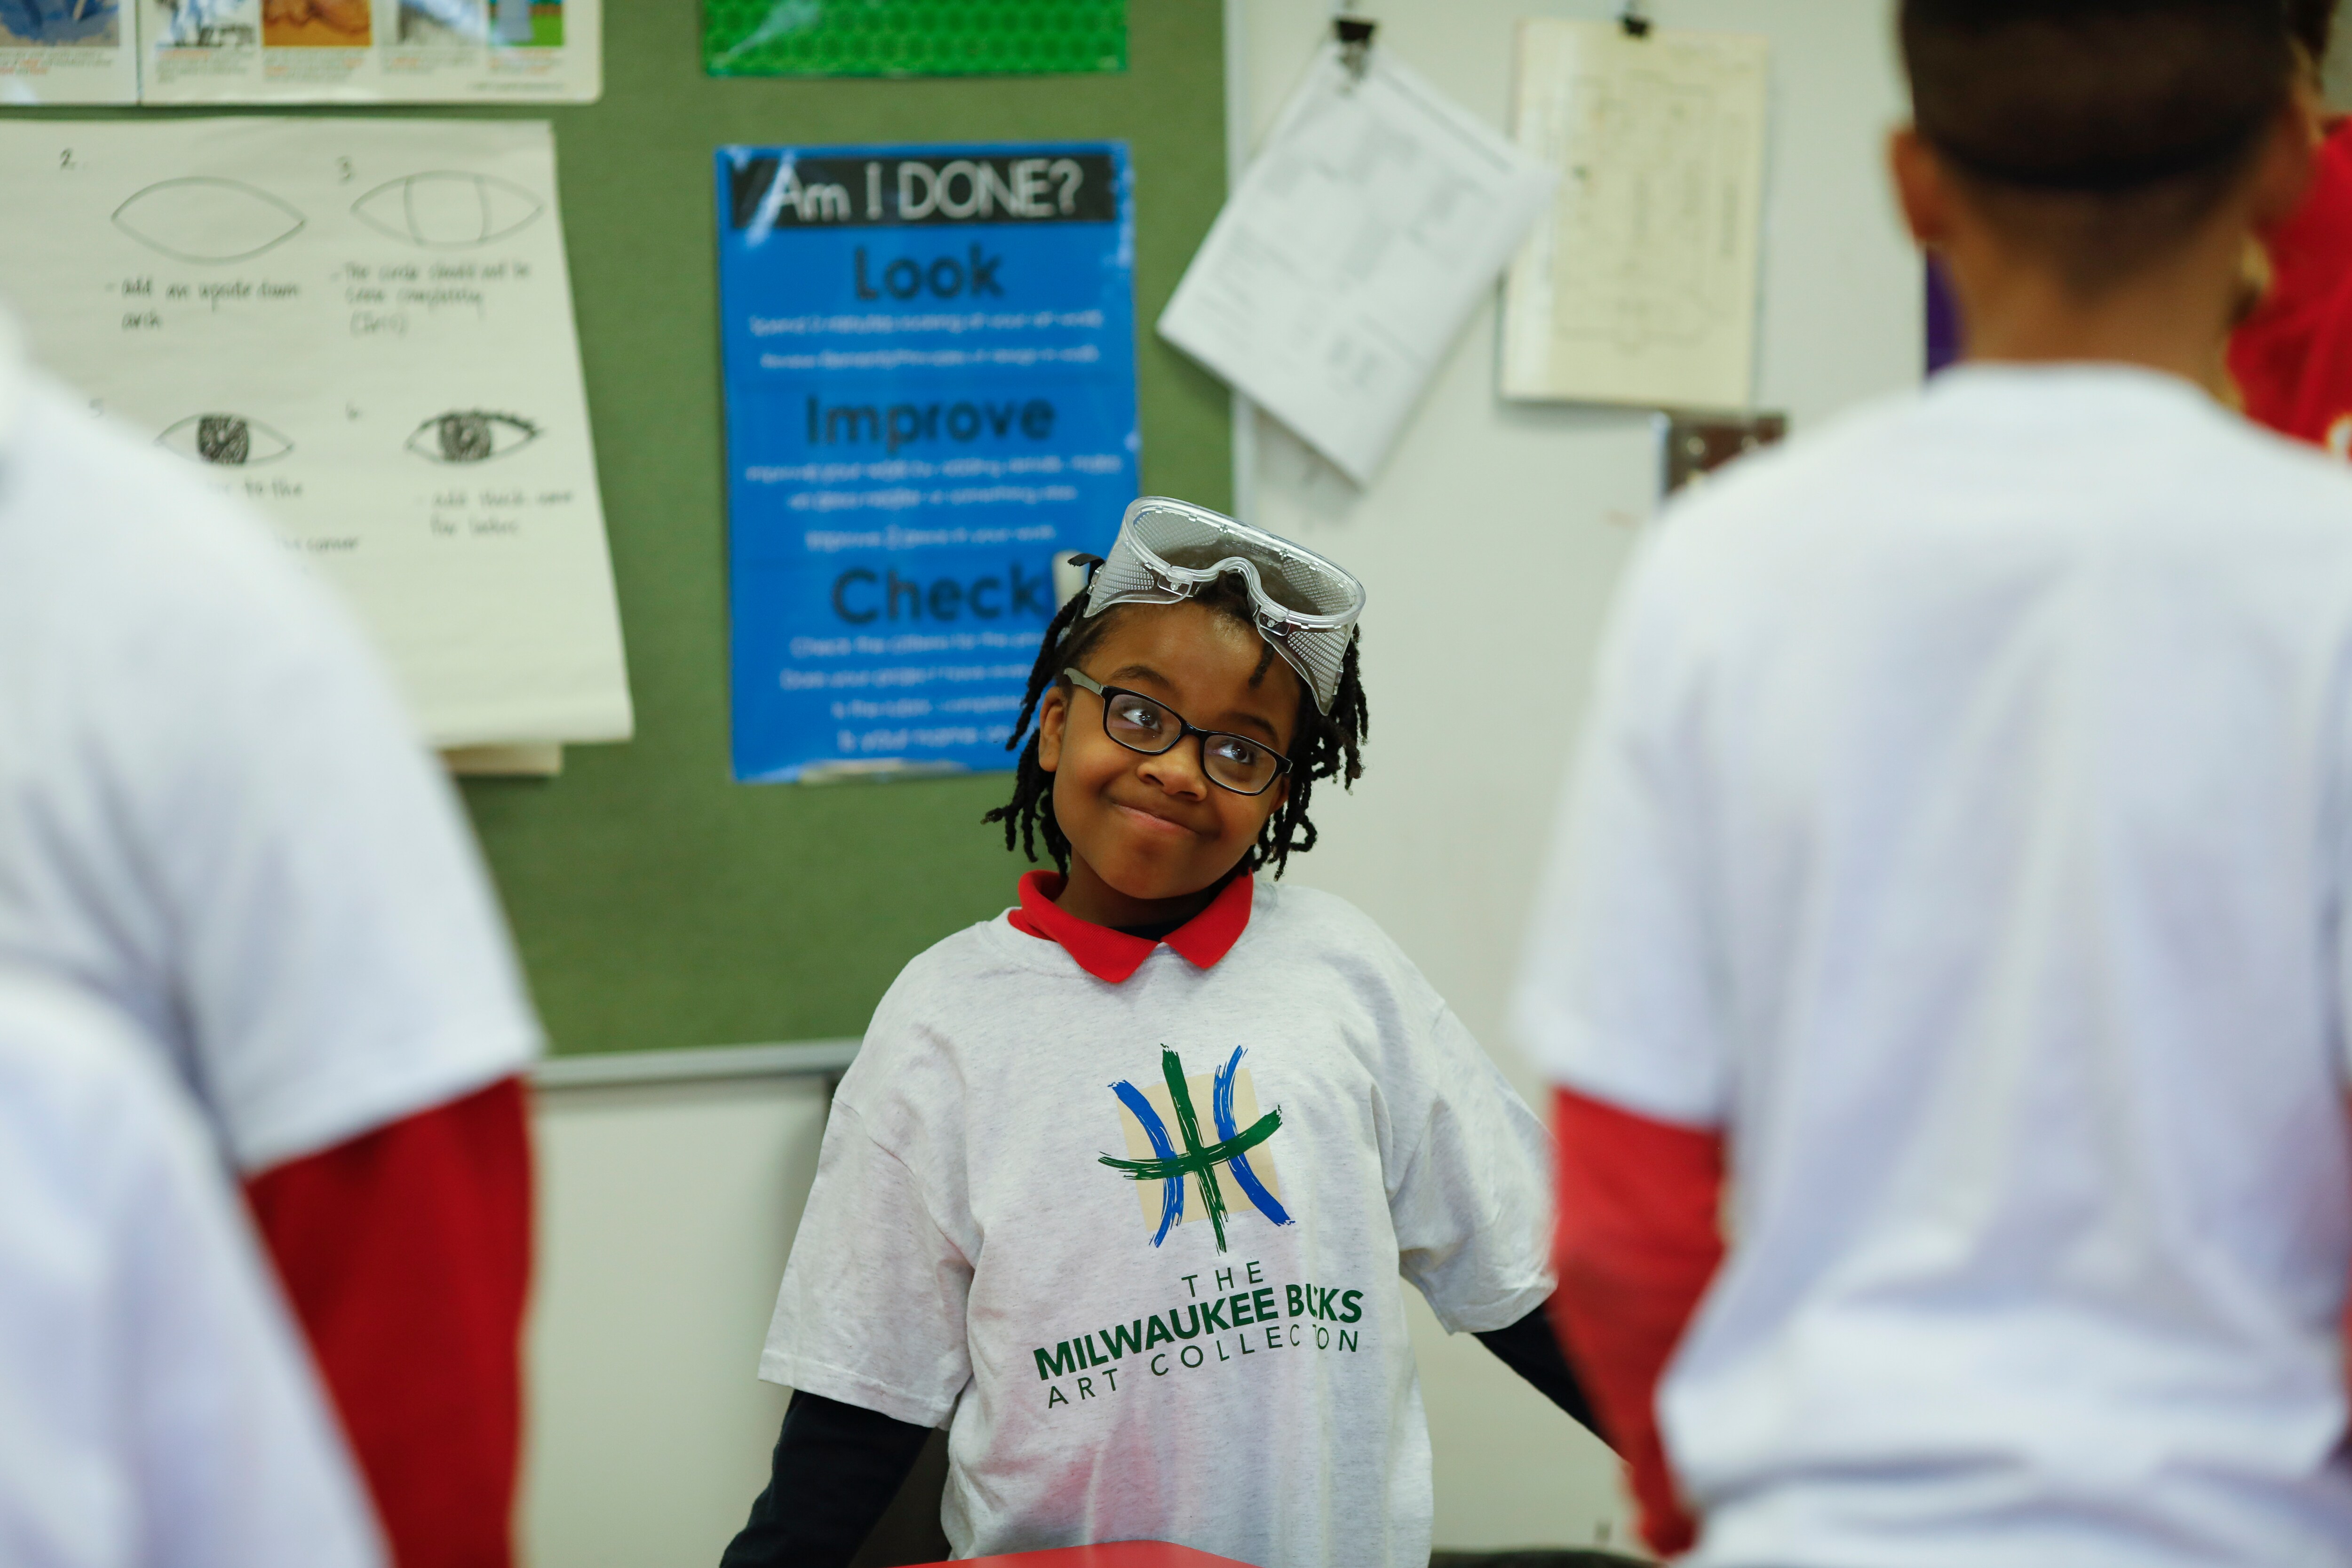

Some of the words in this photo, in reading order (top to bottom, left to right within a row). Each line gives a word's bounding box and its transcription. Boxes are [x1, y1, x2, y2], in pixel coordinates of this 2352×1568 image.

[775, 163, 851, 222] Am
[865, 161, 882, 220] I
[898, 159, 1084, 220] DONE?
[854, 242, 1006, 301] Look
[806, 395, 1057, 454] Improve
[833, 563, 1044, 625] Check
[1181, 1260, 1264, 1297] THE
[1033, 1287, 1279, 1381] MILWAUKEE
[1285, 1283, 1364, 1323] BUKS
[1049, 1368, 1118, 1409] ART
[1151, 1323, 1359, 1377] COLLECON
